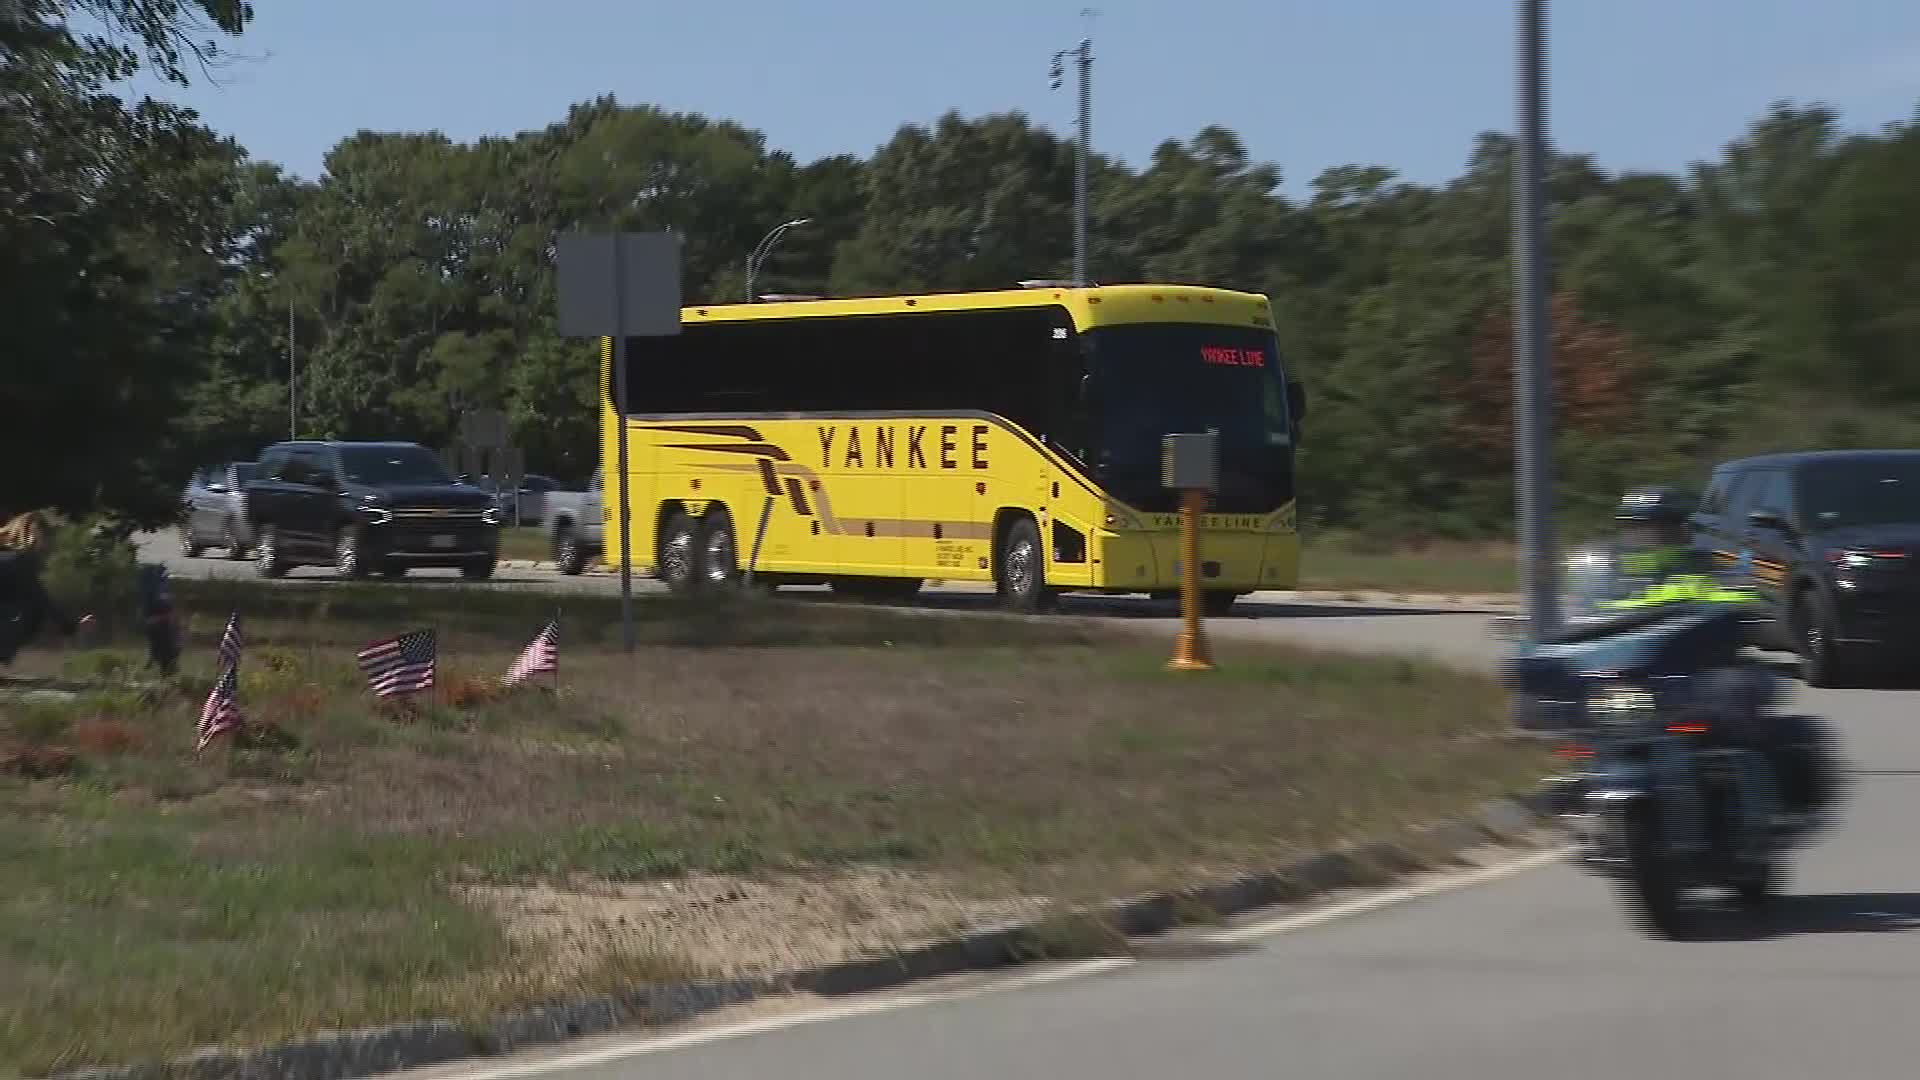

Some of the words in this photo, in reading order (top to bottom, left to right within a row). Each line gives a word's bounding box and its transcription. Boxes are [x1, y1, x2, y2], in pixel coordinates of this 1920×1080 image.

[1200, 346, 1239, 365] YANKEE
[1240, 349, 1265, 367] LINE
[818, 425, 989, 469] YANKEE
[1153, 514, 1218, 527] YANEE
[1225, 515, 1260, 528] LINE
